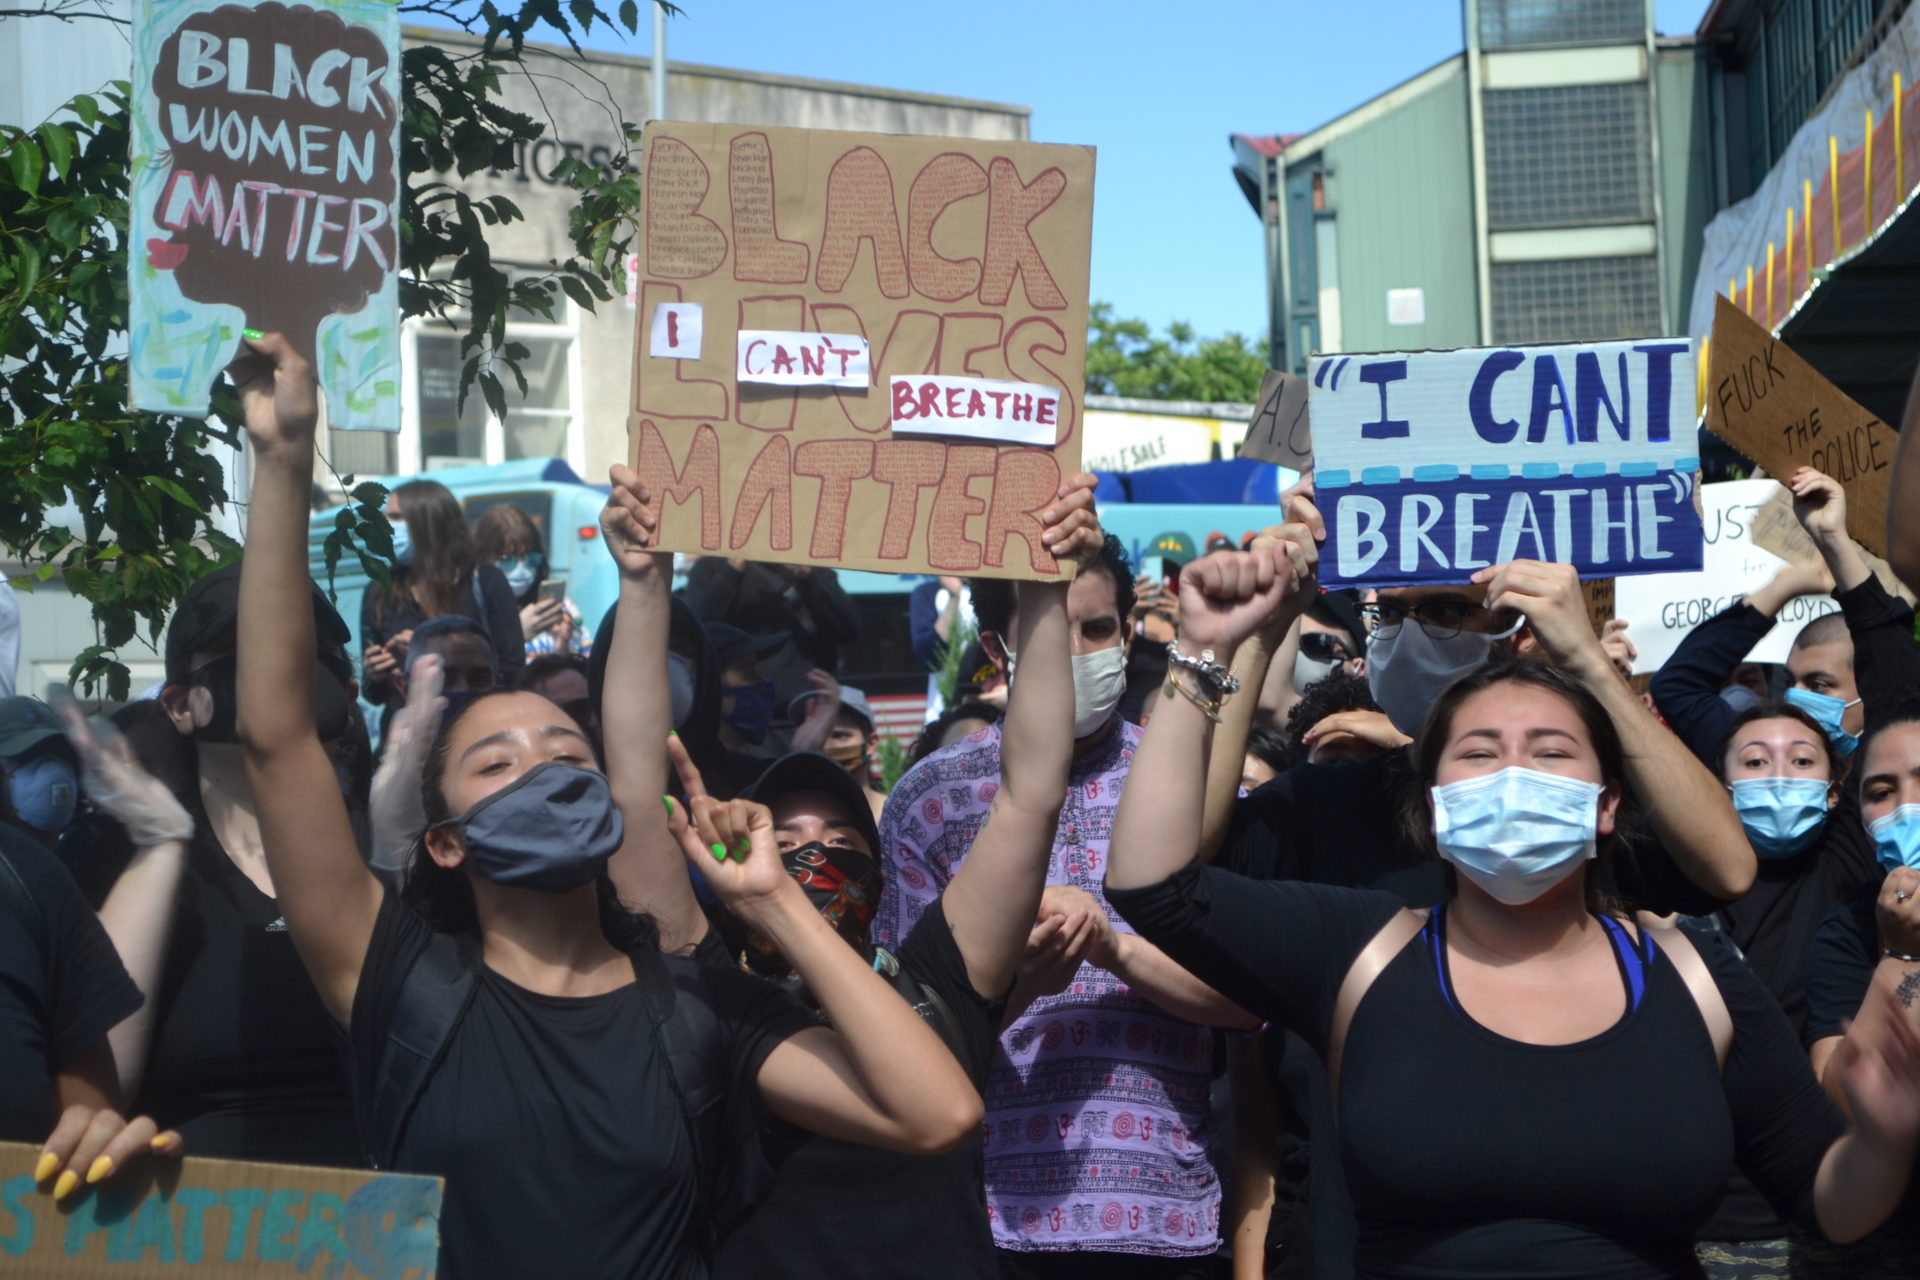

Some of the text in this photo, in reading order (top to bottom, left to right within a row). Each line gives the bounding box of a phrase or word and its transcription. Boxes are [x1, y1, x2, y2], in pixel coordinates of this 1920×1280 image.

[178, 30, 389, 119] BLACK
[169, 104, 375, 184] WOMEN
[162, 170, 391, 273] MATTER
[648, 131, 1068, 310] BLACK
[667, 311, 679, 348] I
[745, 336, 861, 377] CAN'T
[892, 381, 1057, 425] BREATHE
[1469, 344, 1690, 444] CANT
[1717, 341, 1785, 428] FUCK
[1783, 407, 1822, 455] THE
[1811, 420, 1888, 483] POLICE
[638, 419, 1062, 575] MATTER
[1336, 472, 1692, 577] BREATHE"
[1780, 597, 1834, 623] LOYD
[64, 1188, 349, 1276] MATTER
